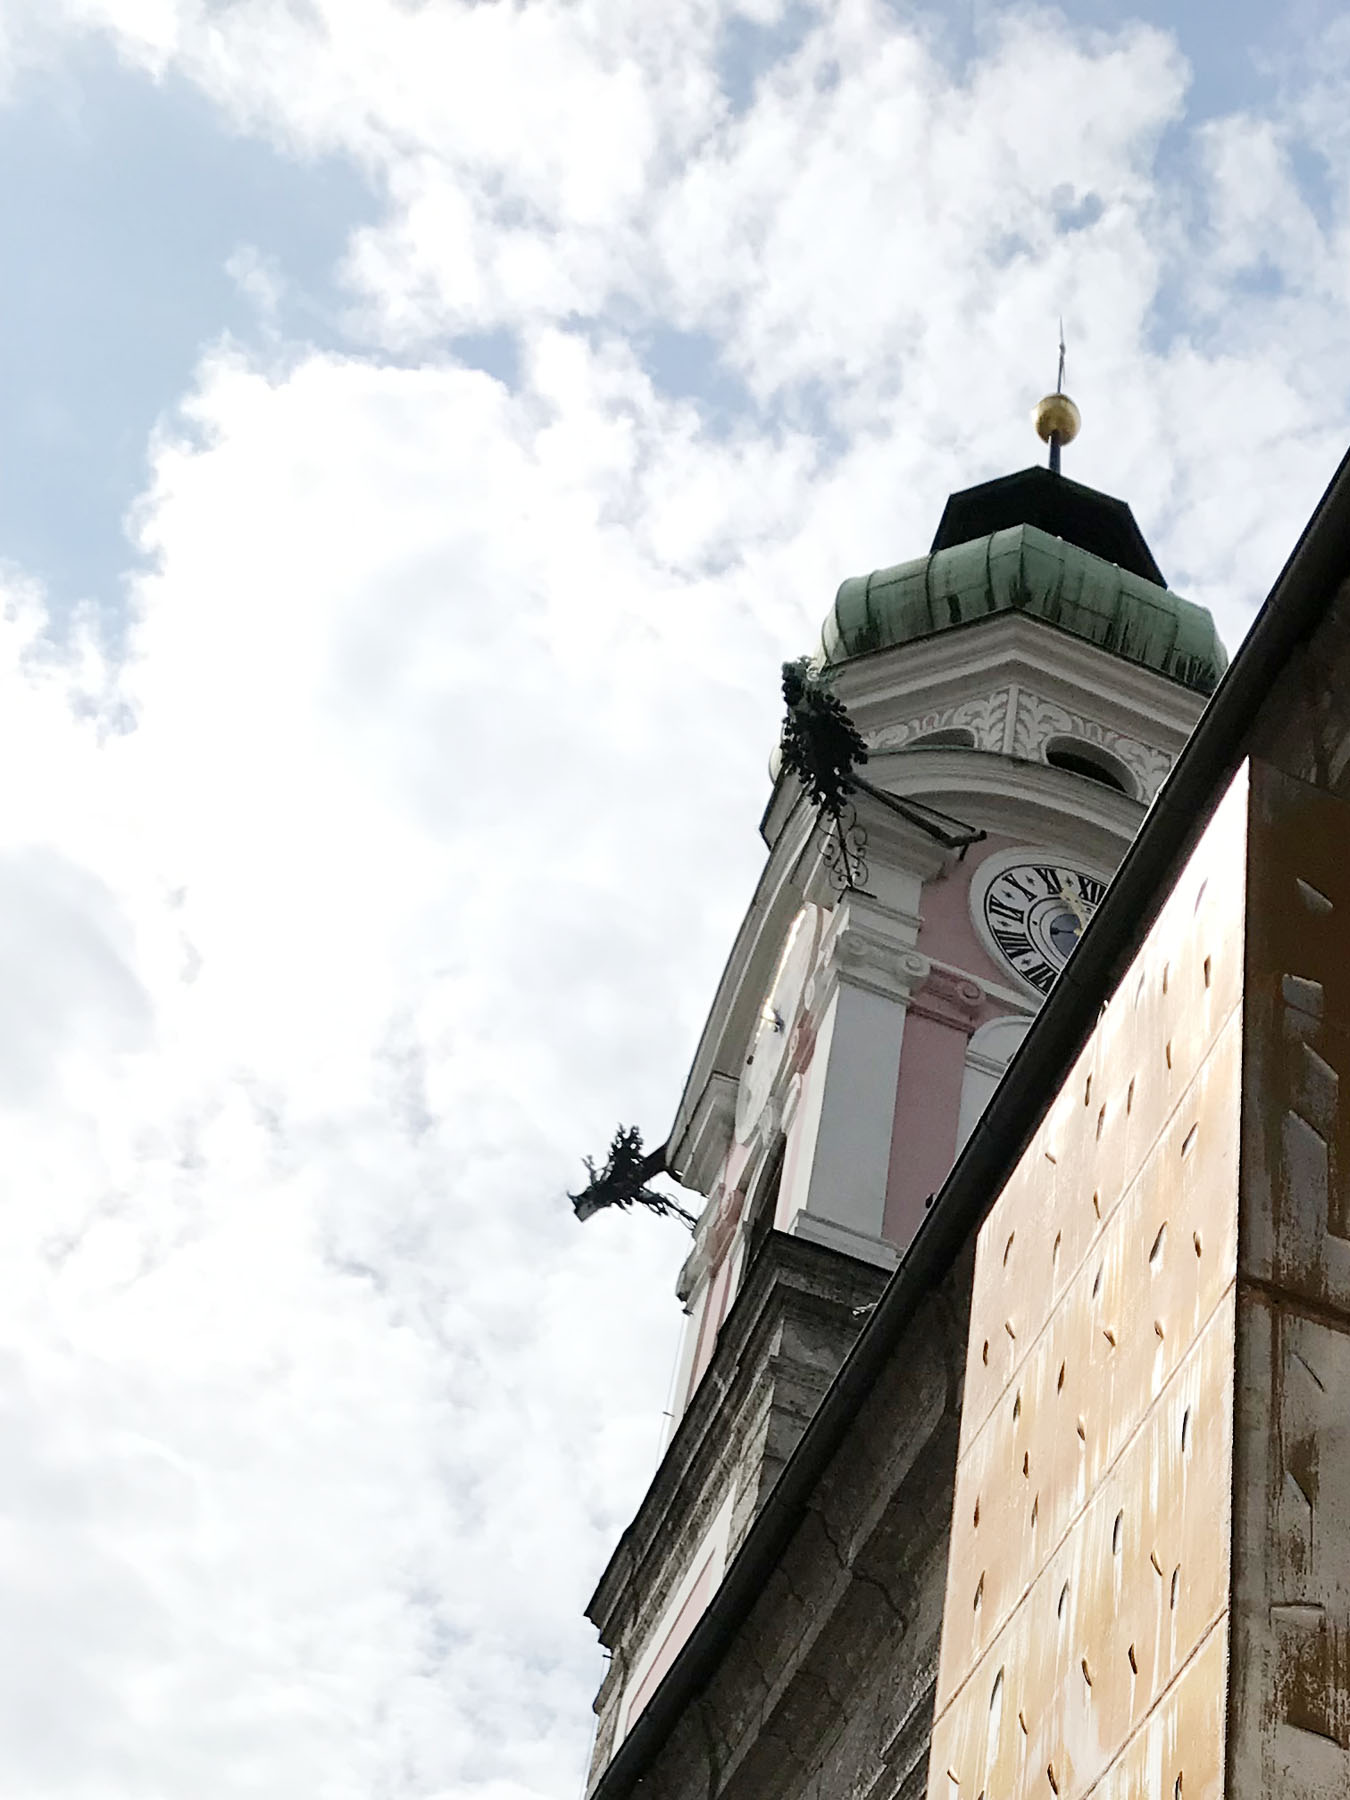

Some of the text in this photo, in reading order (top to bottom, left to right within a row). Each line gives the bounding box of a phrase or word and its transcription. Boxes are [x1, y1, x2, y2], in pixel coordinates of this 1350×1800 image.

[1002, 873, 1037, 902] X
[1032, 867, 1063, 895] XI
[989, 894, 1024, 924] IX
[992, 925, 1037, 960] VIII
